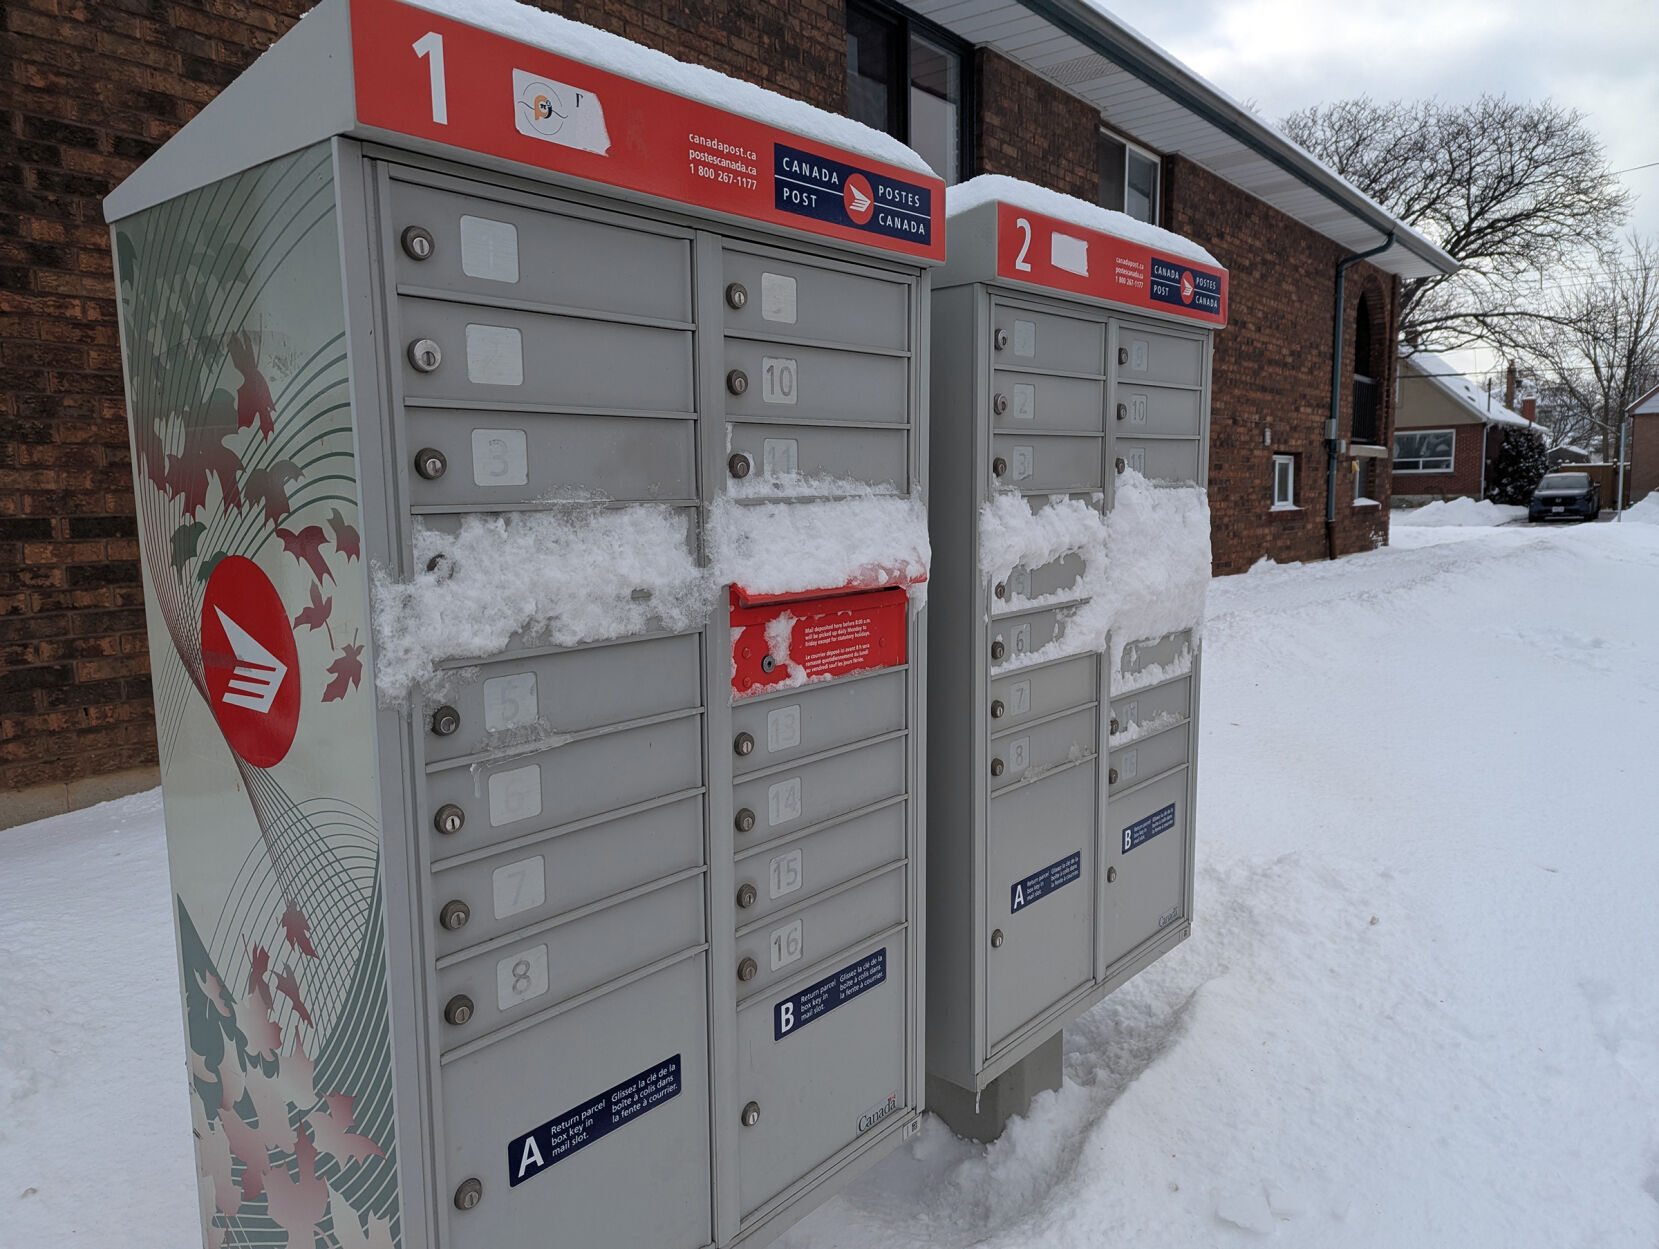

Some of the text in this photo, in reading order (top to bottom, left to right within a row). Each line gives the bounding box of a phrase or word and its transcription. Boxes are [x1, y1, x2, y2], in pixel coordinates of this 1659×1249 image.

[412, 31, 448, 125] 1
[689, 133, 757, 160] canadapost.ca
[689, 149, 757, 175] postescanada.ca
[782, 157, 839, 185] CANADA
[689, 163, 757, 191] 1 800 267-1177
[783, 187, 817, 208] POST
[878, 185, 920, 207] POSTES
[878, 213, 925, 236] CANADA
[1015, 218, 1032, 272] 2
[1154, 265, 1180, 280] CANADA
[1196, 276, 1216, 290] POSTES
[1153, 285, 1169, 296] POST
[1195, 294, 1218, 309] CANADA
[766, 364, 793, 397] 10
[1132, 400, 1144, 420] 10
[488, 439, 509, 477] 3
[768, 446, 791, 475] 11
[1018, 453, 1026, 475] 3
[1017, 630, 1024, 652] 6
[1016, 687, 1024, 706] 7
[771, 713, 796, 745] 13
[1015, 744, 1024, 767] 8
[772, 785, 797, 818] 14
[1125, 829, 1132, 850] B
[773, 858, 797, 890] 15
[508, 870, 526, 906] 7
[1014, 884, 1025, 909] A
[774, 927, 799, 962] 16
[512, 960, 531, 994] 8
[840, 969, 857, 982] Glissez
[870, 958, 878, 966] de
[858, 971, 869, 981] colis
[869, 964, 882, 975] dans
[800, 979, 837, 1004] Return parcel
[800, 993, 829, 1012] box key in
[840, 992, 845, 1000] la
[846, 983, 860, 995] fente
[781, 1002, 795, 1034] B
[801, 1011, 814, 1021] mail
[611, 1063, 676, 1102] Glissez la clé de la
[633, 1093, 638, 1101] à
[640, 1084, 656, 1098] colis
[657, 1075, 674, 1089] dans
[612, 1083, 678, 1123] la fente à courrier.
[858, 1099, 896, 1132] Canada
[551, 1099, 606, 1135] Return parcel
[551, 1118, 594, 1146] box key in
[552, 1132, 589, 1157] mail slot.
[518, 1135, 545, 1178] A
